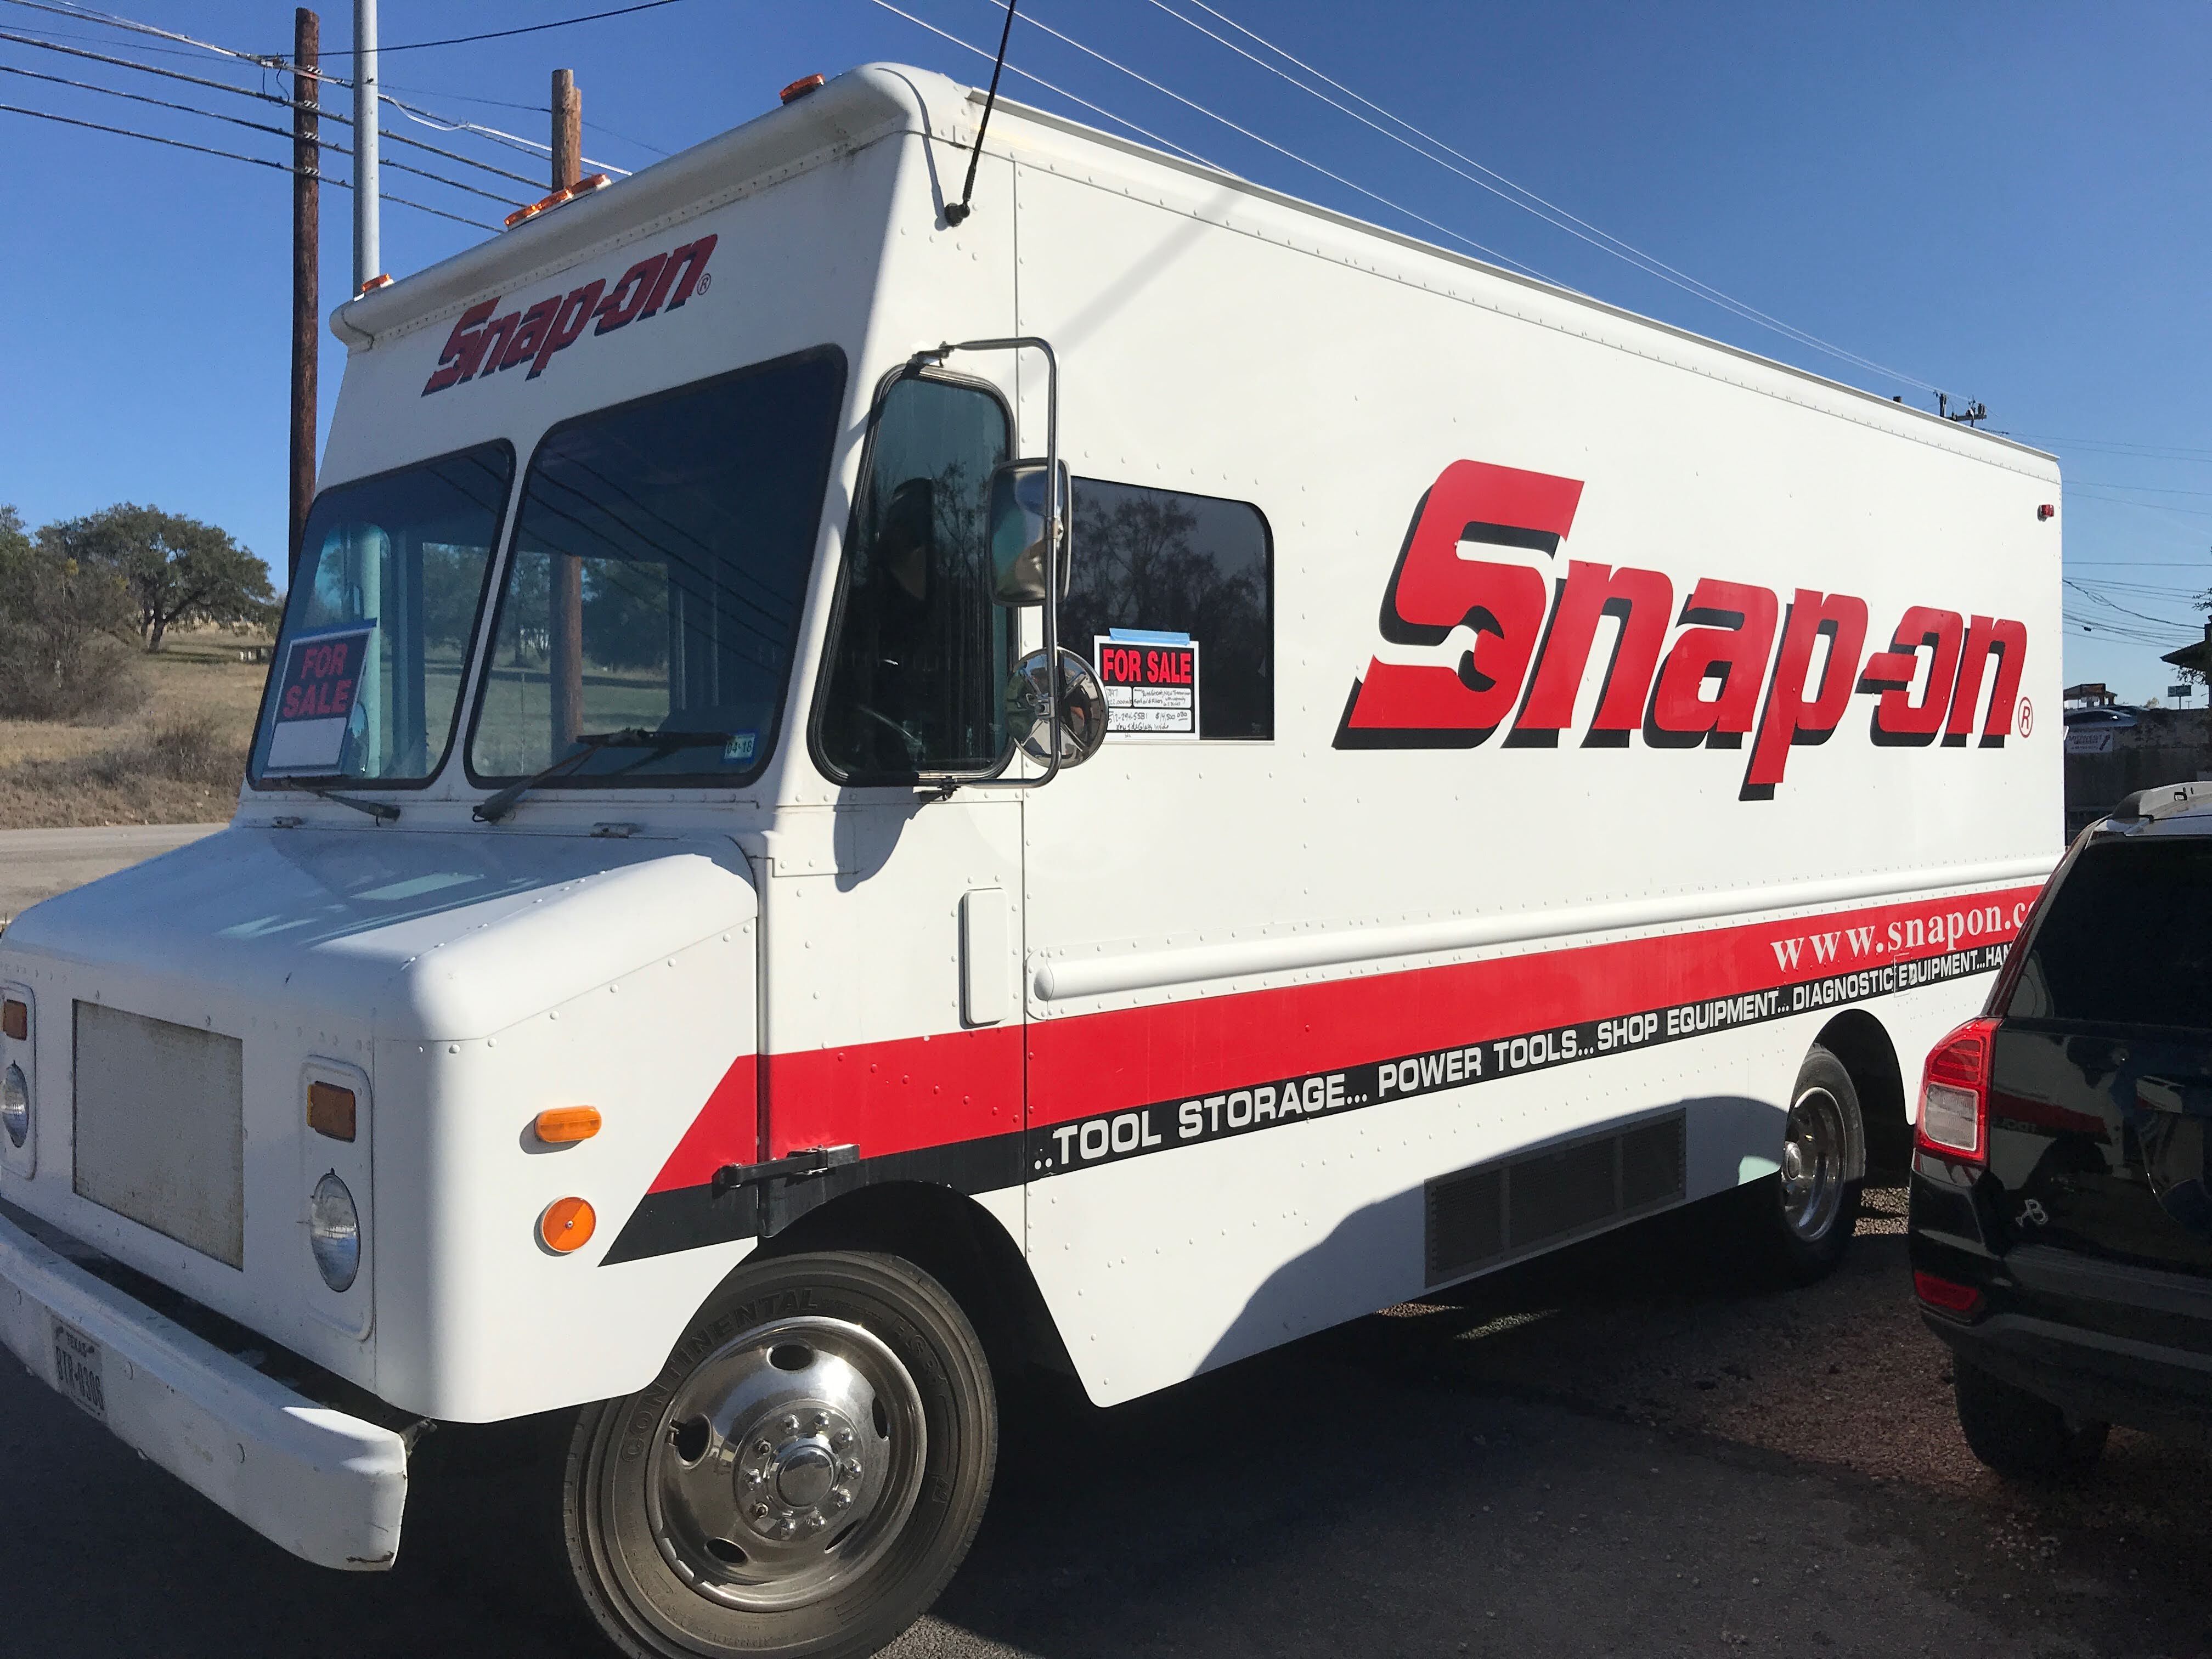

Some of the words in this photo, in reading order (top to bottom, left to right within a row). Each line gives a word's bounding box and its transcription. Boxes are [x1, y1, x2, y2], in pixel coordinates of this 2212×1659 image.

[421, 234, 718, 398] Snap-on
[301, 643, 348, 679] FOR
[1103, 648, 1142, 682] FOR
[1147, 650, 1192, 684] SALE
[1331, 459, 2027, 802] Snap-on
[283, 679, 352, 718] SALE
[1770, 900, 2036, 973] www.snapon.c
[1378, 1047, 1482, 1097] POWER
[1792, 967, 1893, 1012] DIAGNOSTIC
[622, 1289, 818, 1463] CONTINENTAL
